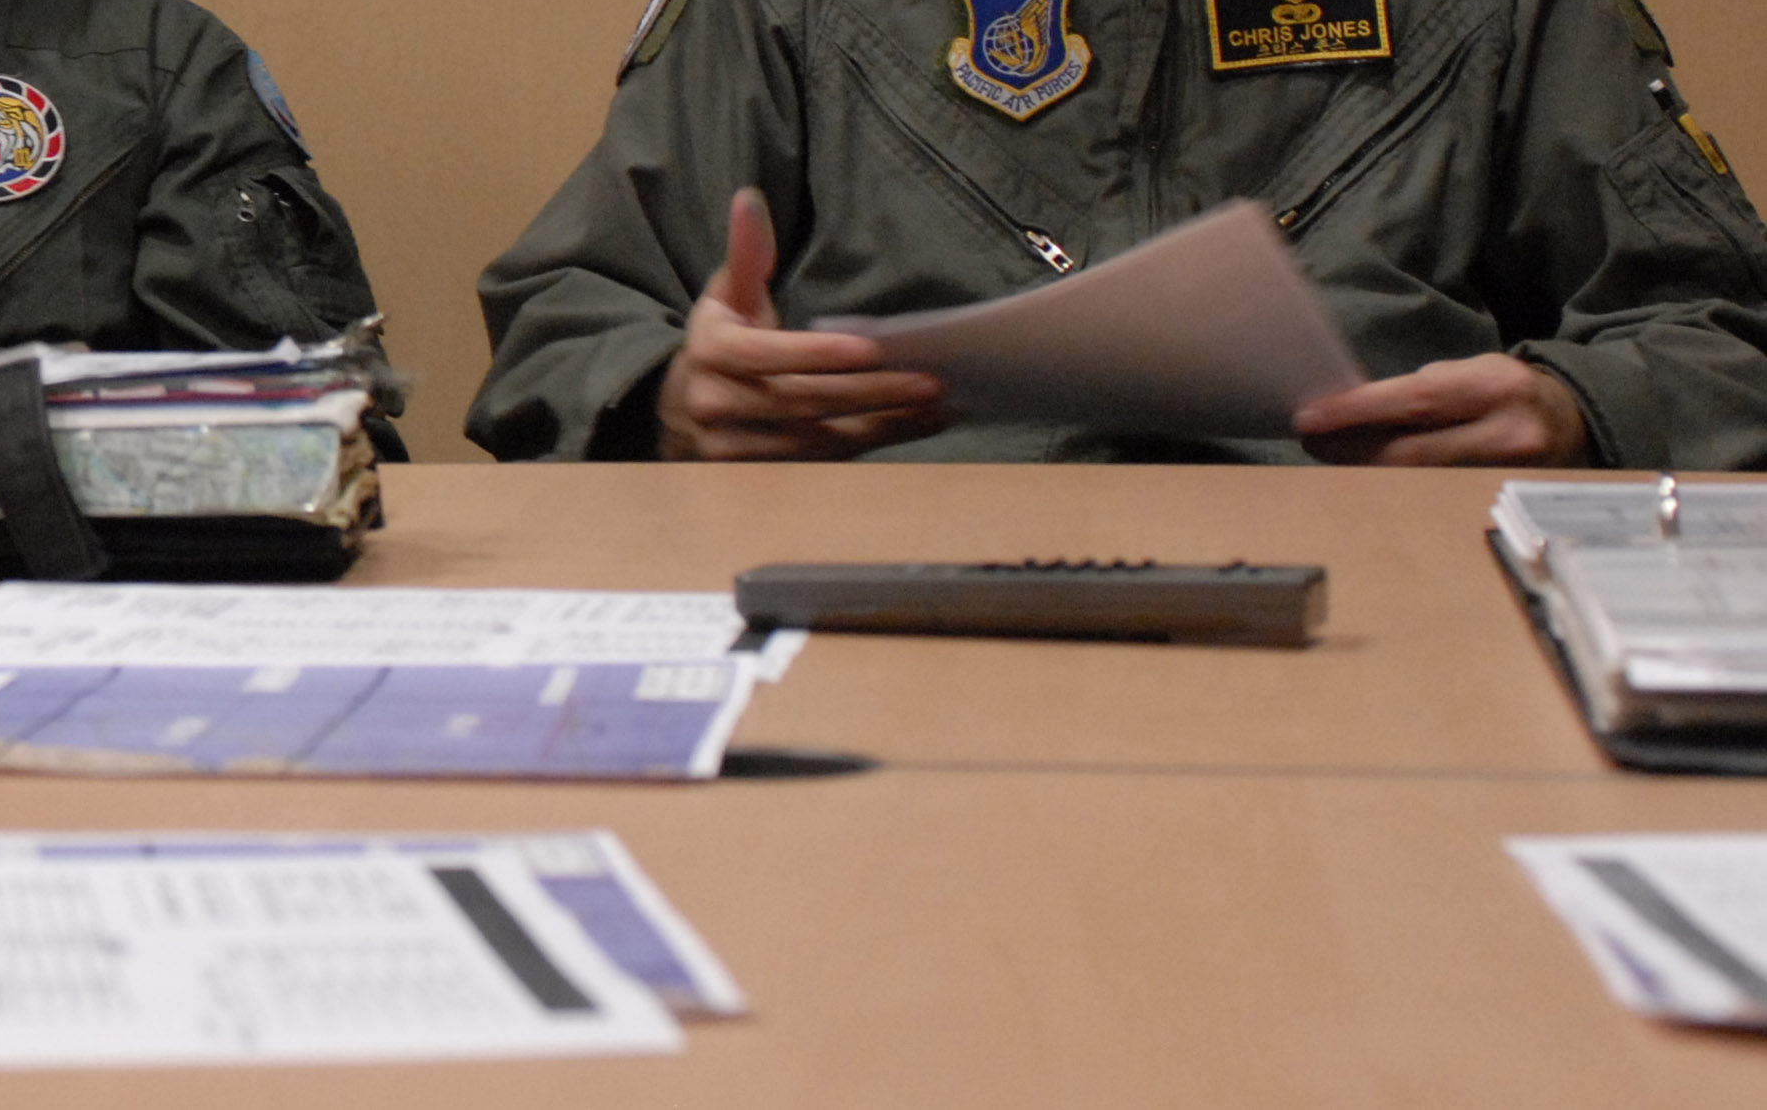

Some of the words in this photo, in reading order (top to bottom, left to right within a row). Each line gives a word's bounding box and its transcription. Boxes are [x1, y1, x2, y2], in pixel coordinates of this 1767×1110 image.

[1228, 25, 1294, 47] CHRIS
[1300, 19, 1372, 41] JONES
[955, 62, 1004, 102] PACIFIC
[1002, 93, 1036, 112] AIR
[1034, 59, 1083, 102] FORCES
